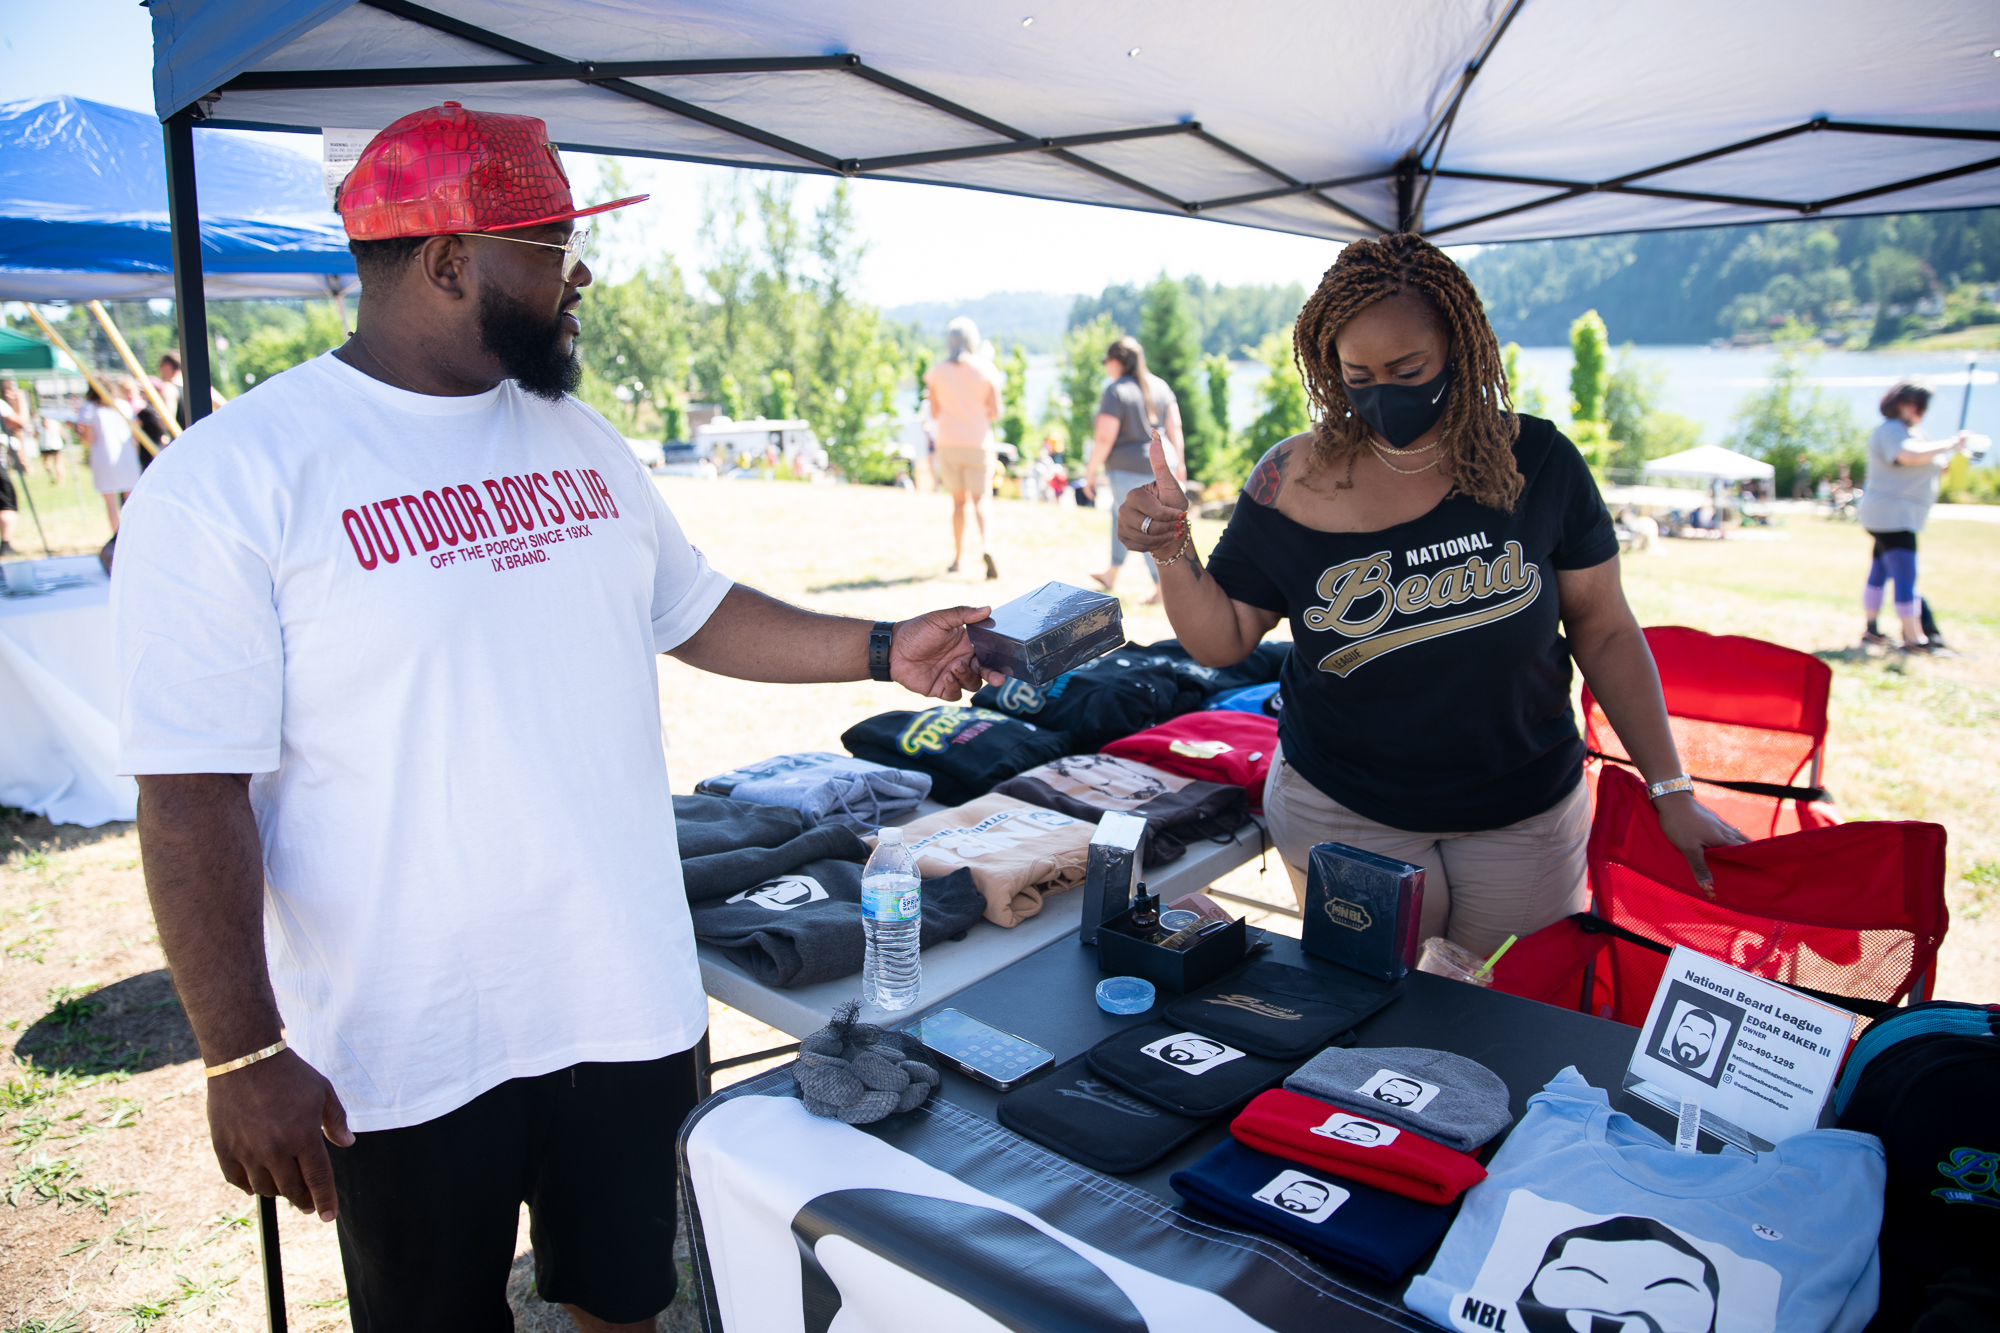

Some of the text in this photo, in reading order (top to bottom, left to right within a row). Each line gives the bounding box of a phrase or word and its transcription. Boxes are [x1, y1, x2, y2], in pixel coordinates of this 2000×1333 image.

[342, 468, 619, 570] OUTDOOR BOYS CLUB
[430, 524, 592, 569] OFF THE PORCH SINCE 19XX
[491, 549, 550, 572] IX BRAND.
[1405, 531, 1493, 566] NATIONAL
[1303, 540, 1540, 638] Beard
[1331, 648, 1363, 670] LEAGUE
[1684, 969, 1823, 1036] National Beard League
[1742, 1025, 1767, 1041] OWNER
[1746, 1015, 1831, 1058] EDGAR BAKER III
[1737, 1038, 1795, 1070] 503-490-1295
[1731, 1053, 1814, 1095] Nationalbeardleague@gmail.com
[1737, 1069, 1794, 1099] @nationalbeardleague
[1733, 1080, 1789, 1111] @nationalbeardleague
[1755, 1224, 1779, 1239] XL
[1461, 1296, 1507, 1333] NBL
